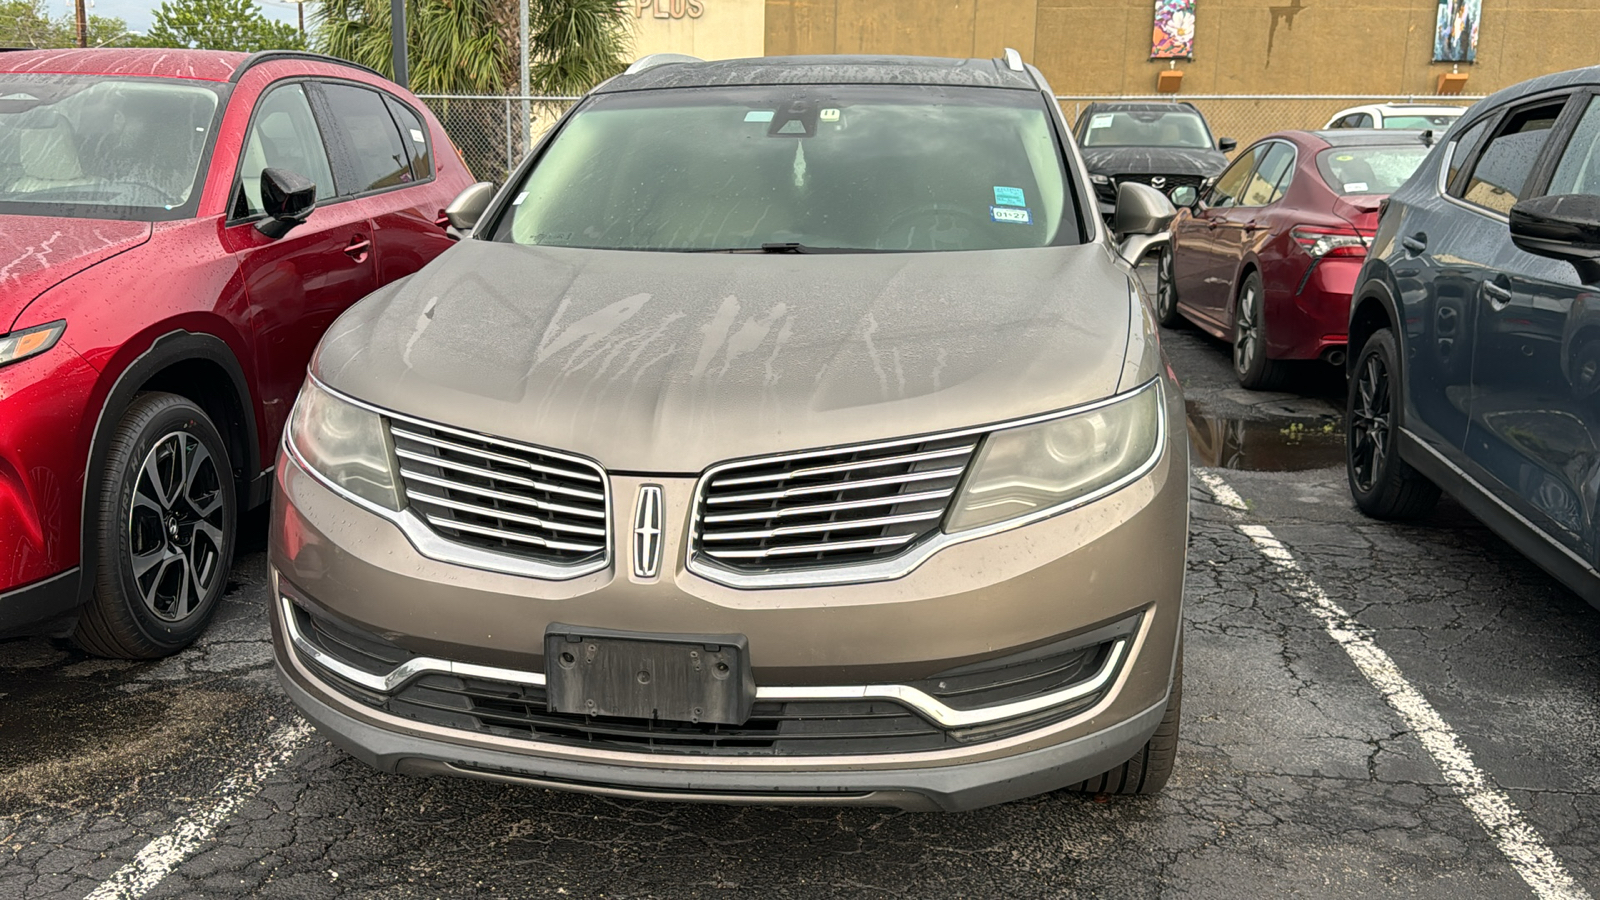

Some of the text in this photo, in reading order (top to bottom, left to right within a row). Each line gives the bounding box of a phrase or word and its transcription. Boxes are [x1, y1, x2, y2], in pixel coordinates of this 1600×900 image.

[635, 0, 704, 19] PLUS
[996, 211, 1026, 219] 01-27
[119, 481, 131, 574] OUNTRY
